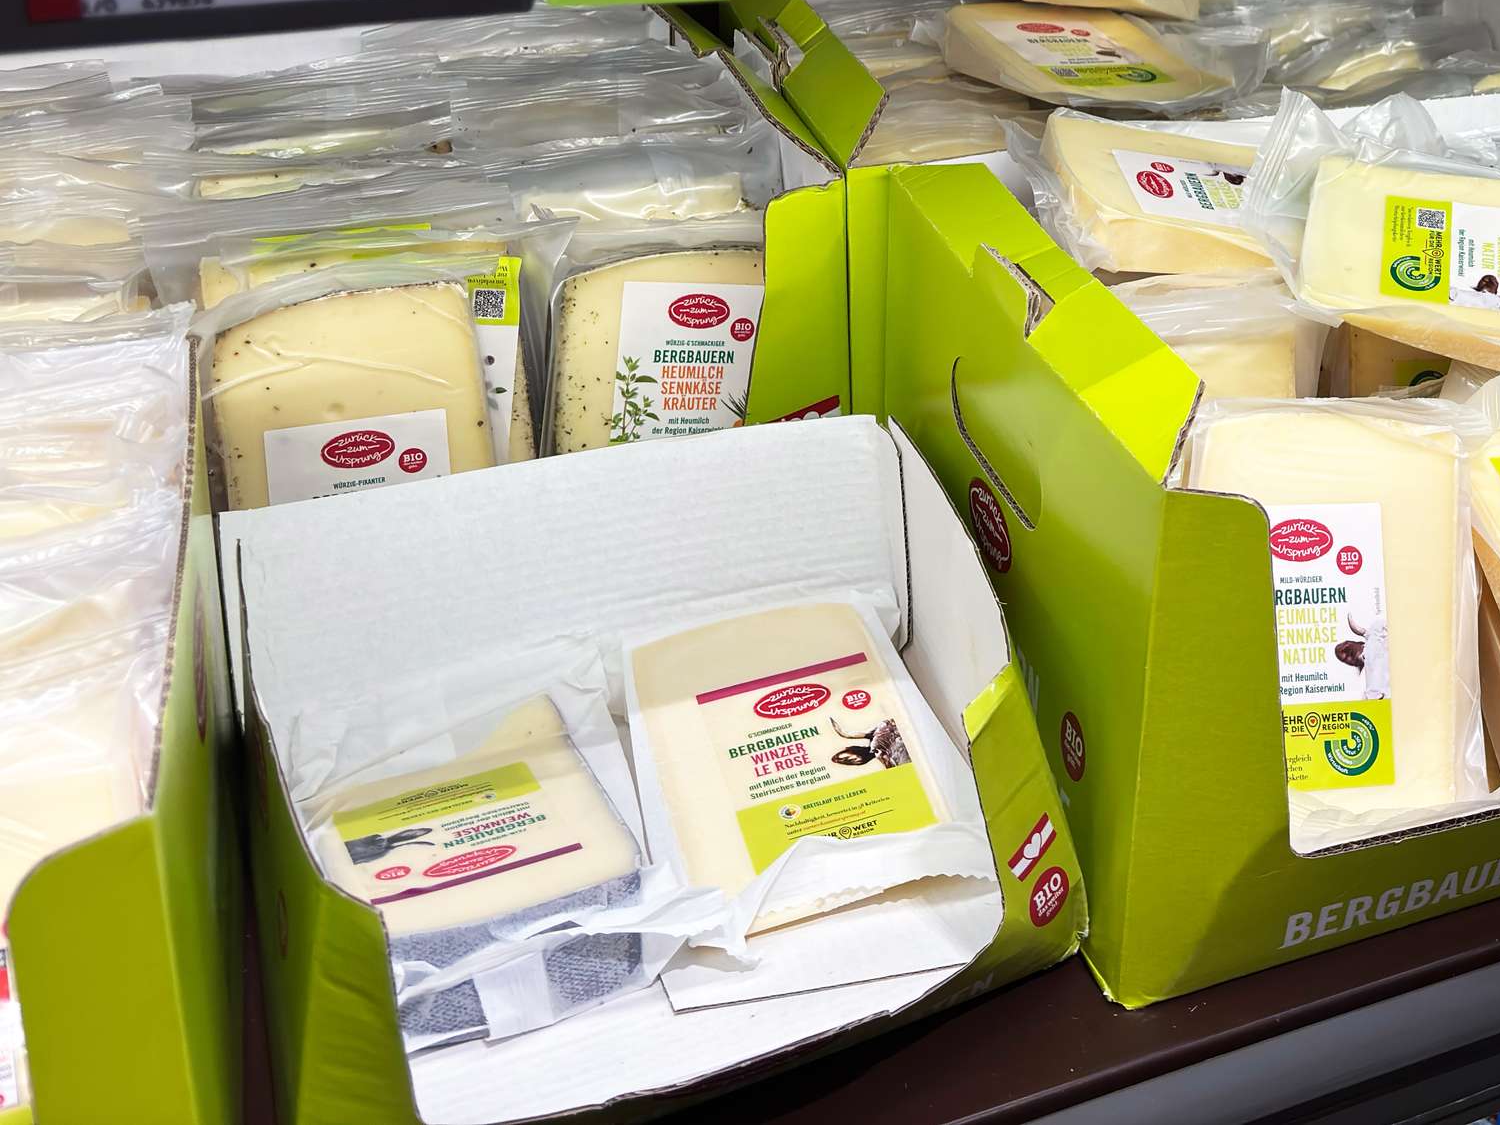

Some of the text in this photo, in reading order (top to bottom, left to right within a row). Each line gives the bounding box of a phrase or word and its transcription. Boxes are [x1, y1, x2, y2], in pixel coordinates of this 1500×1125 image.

[735, 323, 751, 331] BIO
[654, 350, 734, 364] BERGBAUERN
[662, 366, 723, 379] HEUMILCH
[661, 378, 721, 395] SENNKÄSE
[664, 395, 717, 410] KRÄUTER
[403, 453, 422, 462] BIO
[333, 477, 385, 490] WÜRZIG-PIKANTER
[1340, 552, 1359, 562] BIO
[1275, 587, 1347, 606] RGBAUERN
[1278, 607, 1338, 626] EUMILCH
[1279, 622, 1338, 646] ENNKÄSE
[1283, 647, 1327, 664] NATUR
[1295, 672, 1328, 683] Heumilch
[846, 692, 866, 703] BIO
[1322, 713, 1349, 723] WERT
[1322, 722, 1350, 731] REGION
[729, 726, 819, 759] BERGBAUERN
[751, 743, 806, 765] WINZER
[755, 766, 771, 777] LE
[763, 766, 826, 789] Milch Region
[750, 773, 831, 800] Steirisches Bergland
[853, 820, 878, 832] WERT
